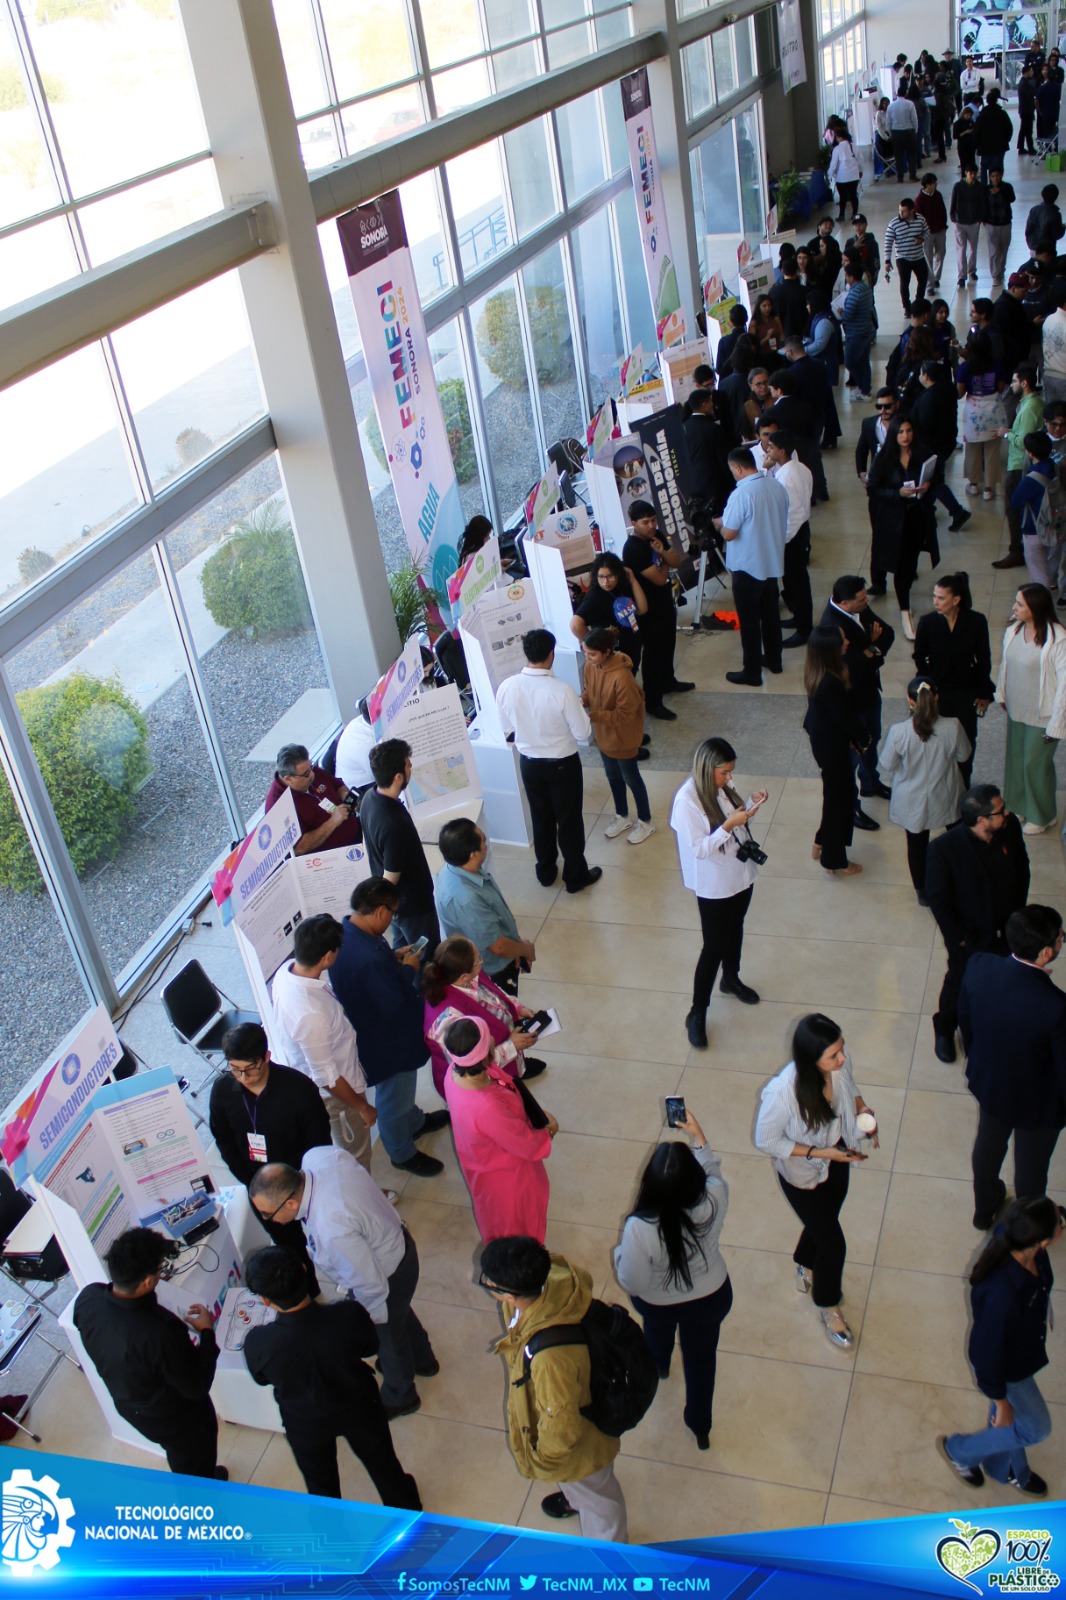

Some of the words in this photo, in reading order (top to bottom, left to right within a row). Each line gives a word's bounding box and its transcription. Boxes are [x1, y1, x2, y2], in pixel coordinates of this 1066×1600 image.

[636, 126, 653, 224] FEMECI
[360, 224, 388, 248] SONORA
[397, 286, 409, 324] 2024
[376, 280, 416, 430] FEMECI
[405, 327, 421, 395] SONORA
[651, 460, 664, 487] DE
[417, 481, 440, 544] AGUA
[658, 488, 676, 536] CLUB
[618, 604, 636, 619] NASA
[240, 822, 298, 901] SEMICONDUCTORES
[39, 1042, 118, 1150] SEMICONDUCTORES
